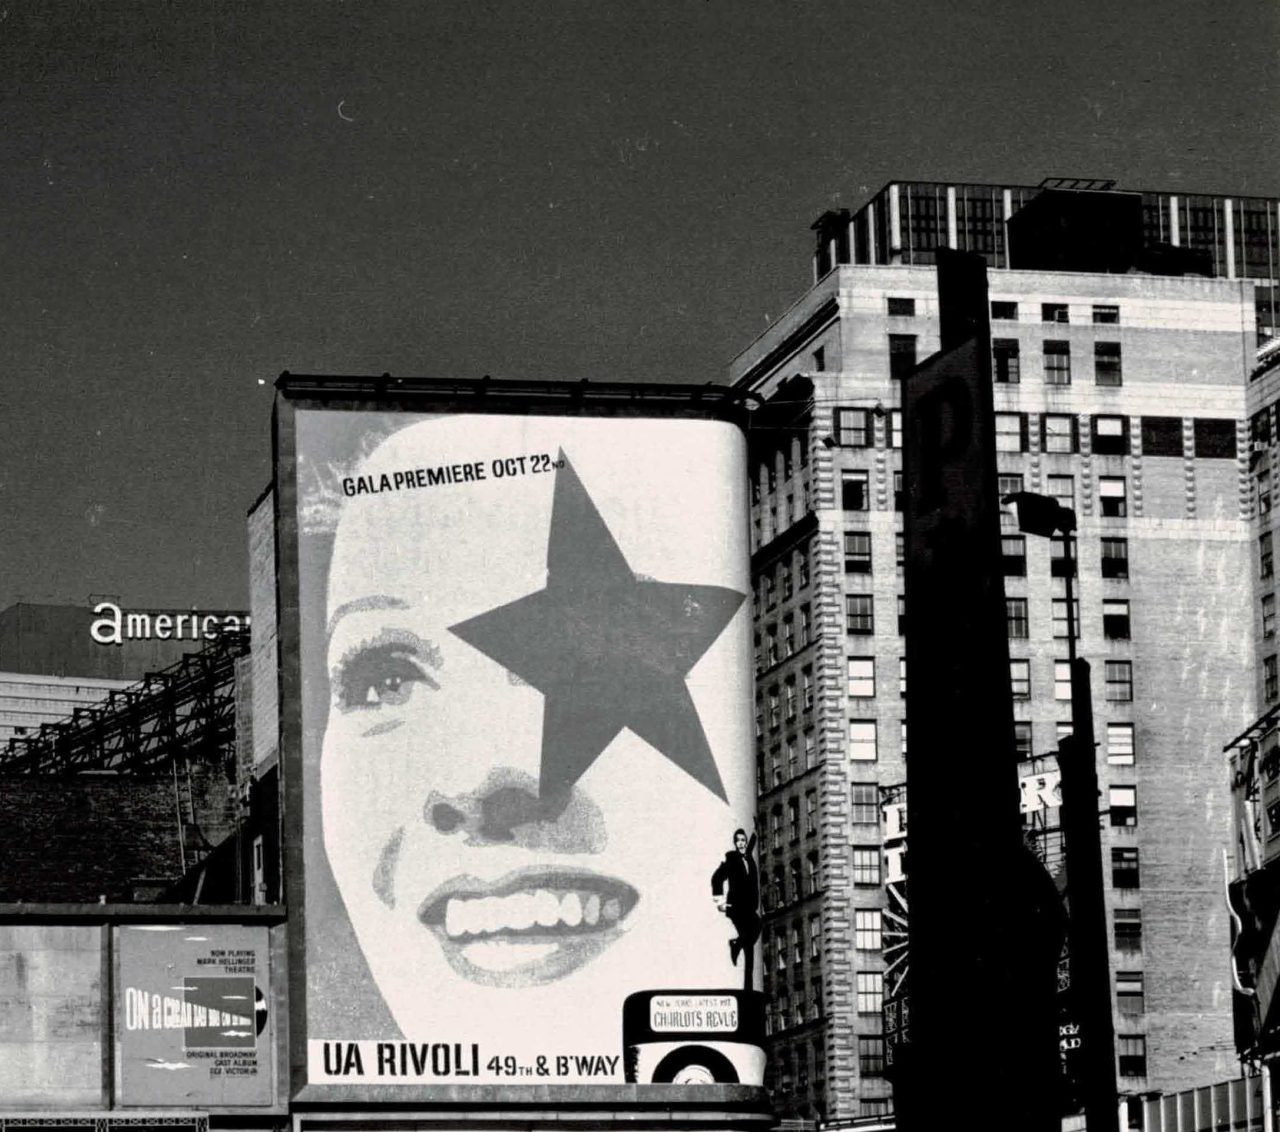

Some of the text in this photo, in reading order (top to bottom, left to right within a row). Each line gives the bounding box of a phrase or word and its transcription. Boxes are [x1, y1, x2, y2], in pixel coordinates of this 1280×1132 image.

[342, 453, 565, 497] GALA PREMIERE OCT 22ND
[125, 987, 150, 1031] ON
[322, 1043, 365, 1076] UA
[376, 1043, 479, 1076] RIVOLI
[535, 1055, 550, 1077] &
